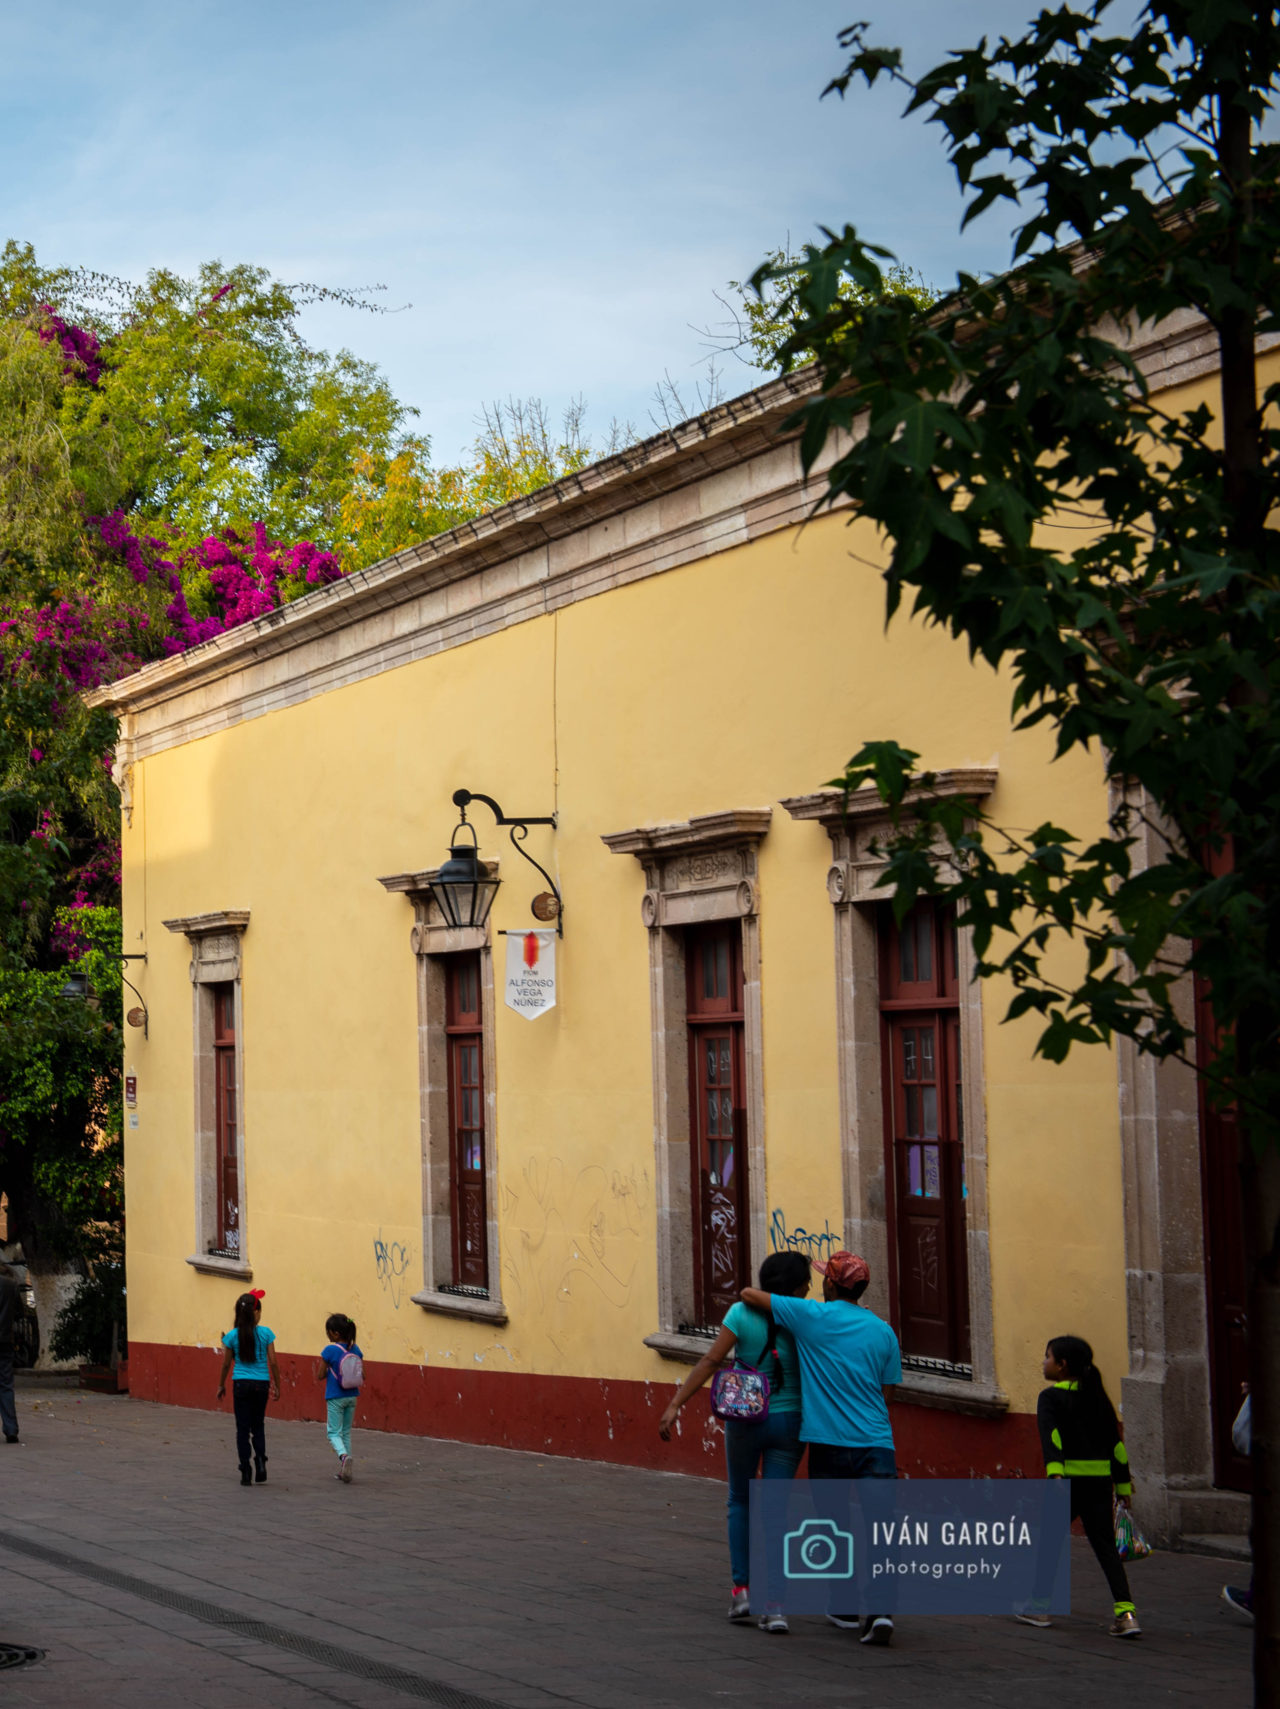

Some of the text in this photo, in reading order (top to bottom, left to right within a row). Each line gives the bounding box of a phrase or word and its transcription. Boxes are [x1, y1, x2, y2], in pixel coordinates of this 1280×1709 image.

[508, 979, 554, 987] ALFONSO
[516, 988, 543, 996] VEGA
[513, 997, 546, 1007] NÚÑEZ
